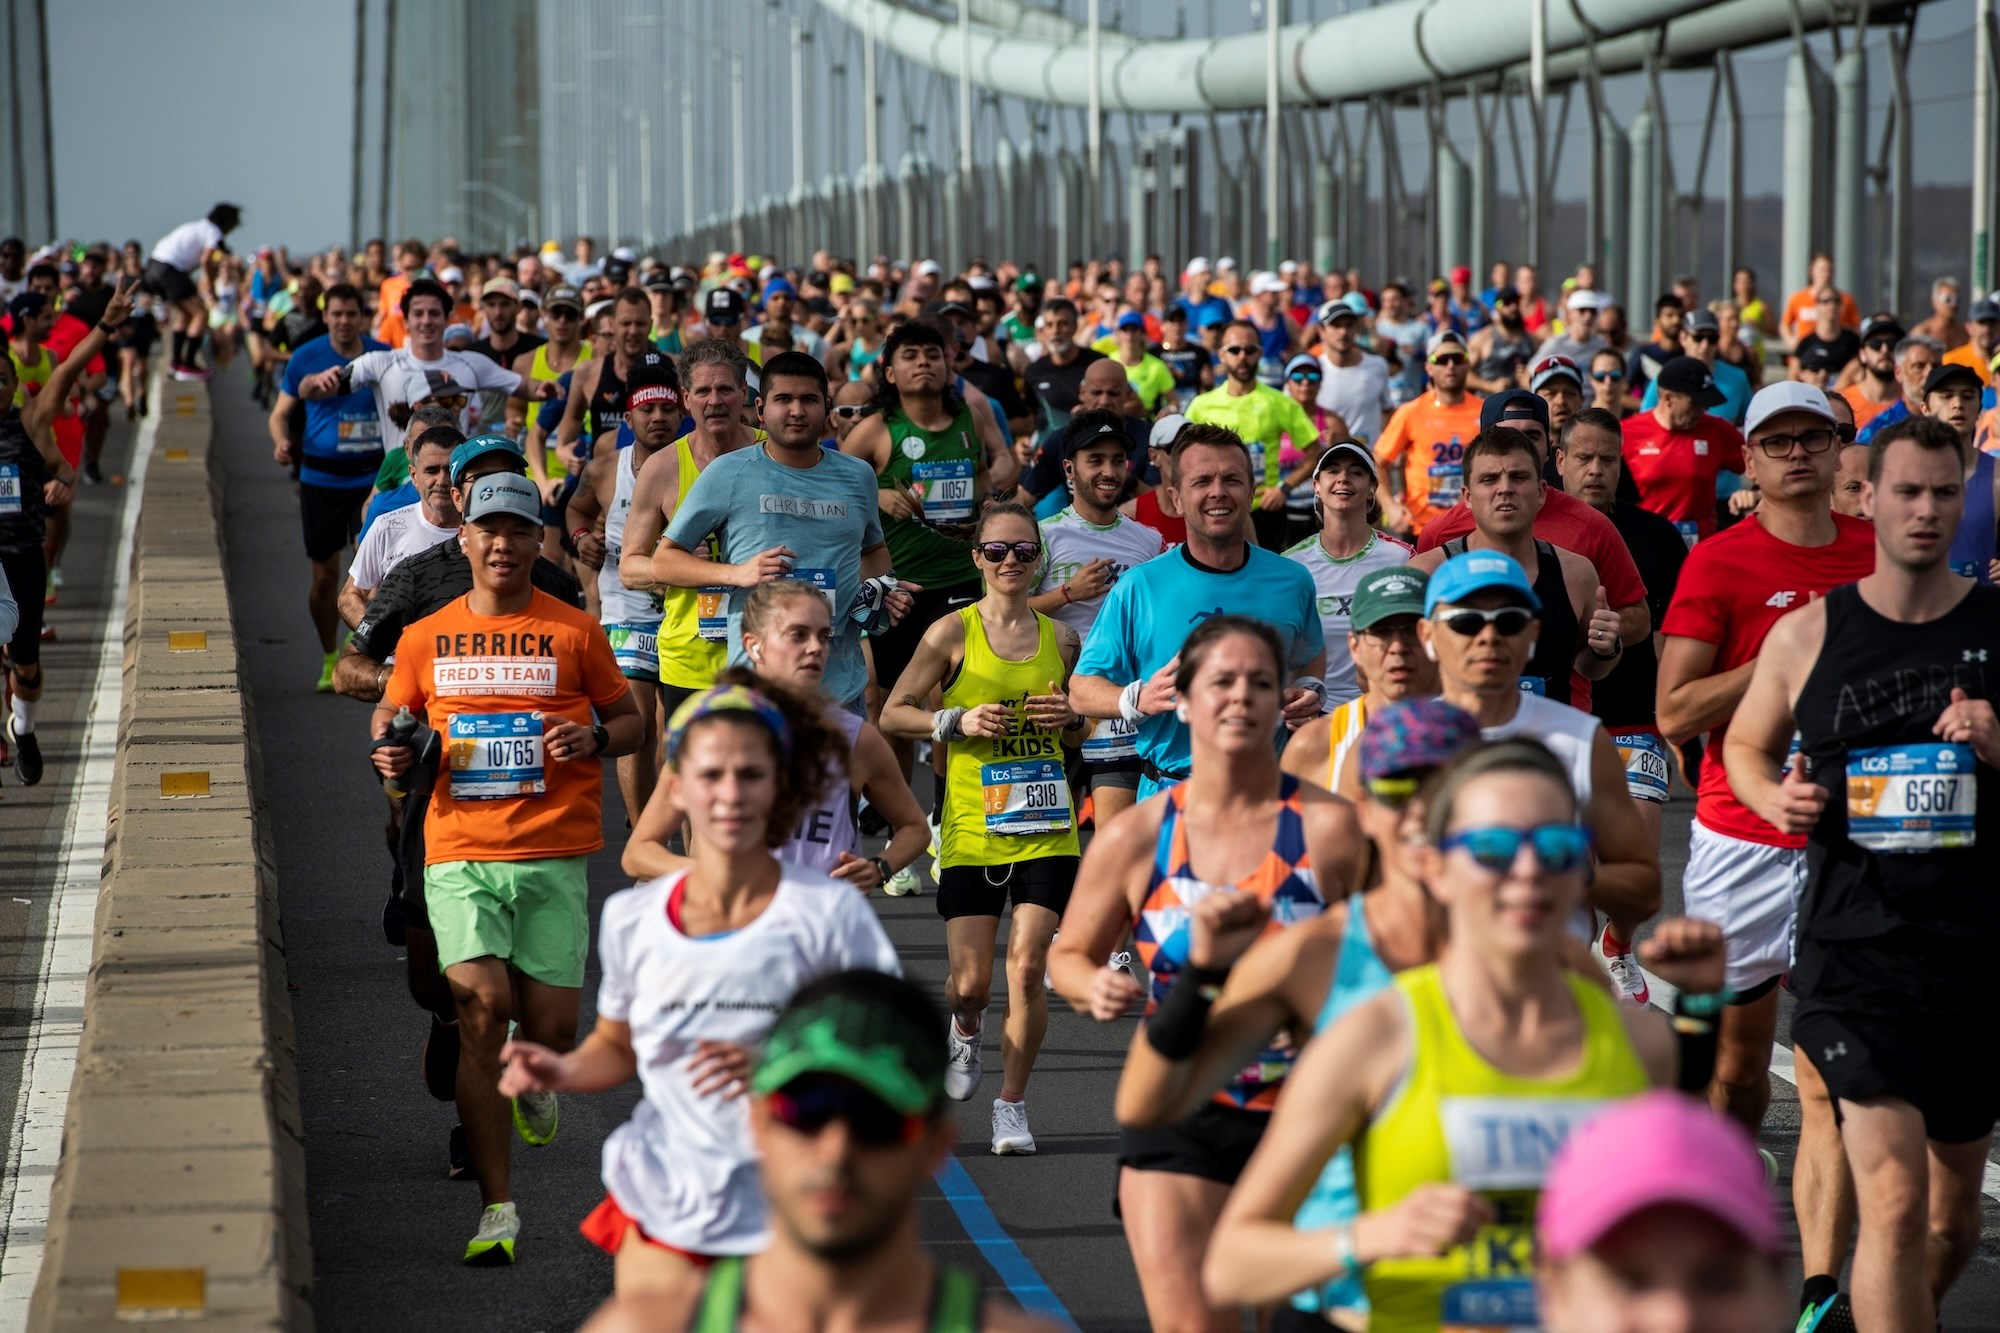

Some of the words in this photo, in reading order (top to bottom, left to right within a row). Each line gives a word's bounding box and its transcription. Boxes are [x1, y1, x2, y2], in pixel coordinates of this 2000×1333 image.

[496, 486, 532, 498] Fillnow
[942, 480, 967, 500] 11057
[764, 498, 845, 516] CHRISTIAN
[706, 594, 713, 604] 3
[1766, 591, 1797, 608] 4F
[706, 607, 714, 615] C
[436, 633, 555, 658] DERRICK
[439, 668, 495, 682] FRED'S
[502, 668, 550, 680] TEAM
[528, 688, 556, 696] CANCER
[457, 720, 476, 734] tcs
[488, 740, 534, 767] 10765
[1002, 738, 1055, 757] KIDS
[1641, 752, 1664, 780] 8238
[1862, 757, 1890, 772] tcs
[991, 770, 1010, 782] tcs
[994, 788, 1000, 796] 1
[1026, 783, 1058, 808] 6318
[1906, 780, 1958, 812] 6567
[994, 802, 1002, 810] C
[1861, 800, 1873, 812] C
[1476, 1116, 1570, 1167] TIN
